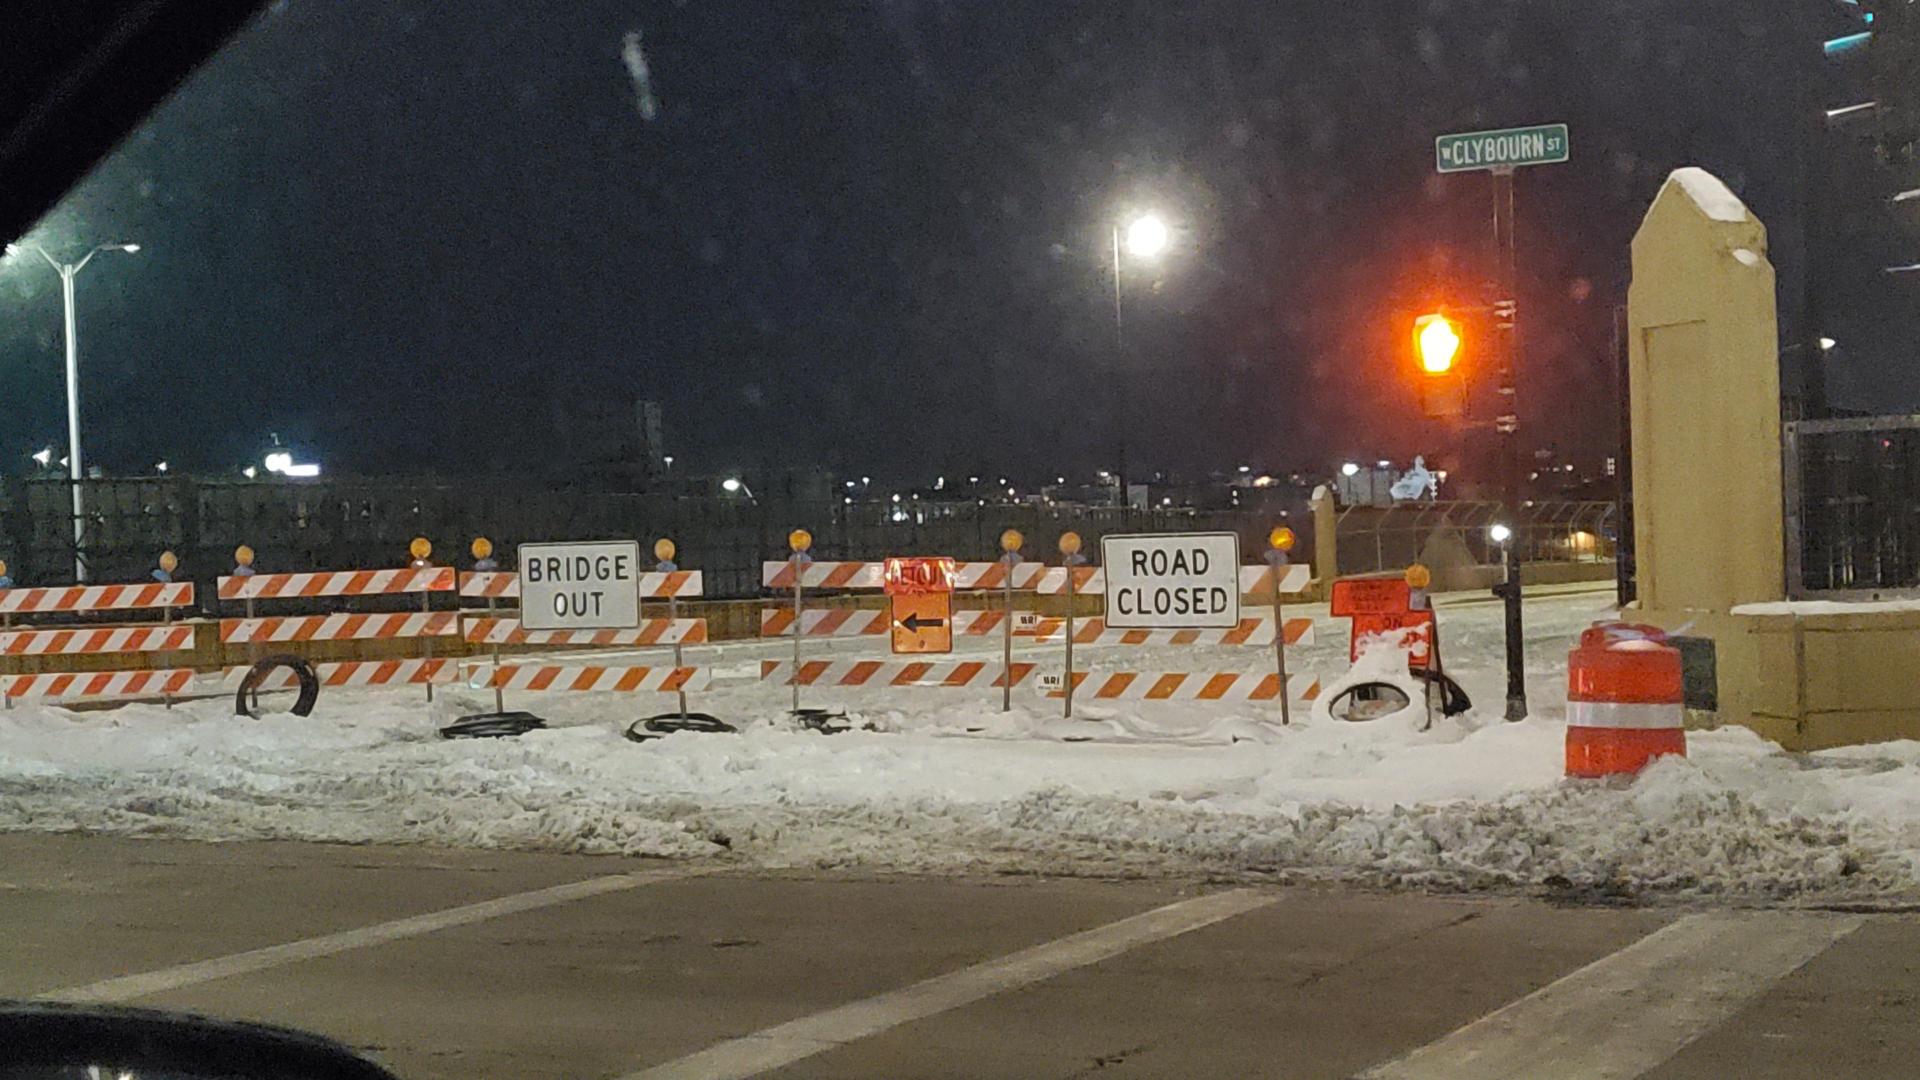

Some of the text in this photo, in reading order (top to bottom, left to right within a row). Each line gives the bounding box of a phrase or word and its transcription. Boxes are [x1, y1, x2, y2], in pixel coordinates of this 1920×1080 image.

[1441, 134, 1561, 165] W CLYBOURN ST
[528, 555, 629, 582] BRIDGE
[1131, 548, 1209, 576] ROAD
[553, 591, 604, 617] OUT
[1117, 587, 1227, 615] CLOSED
